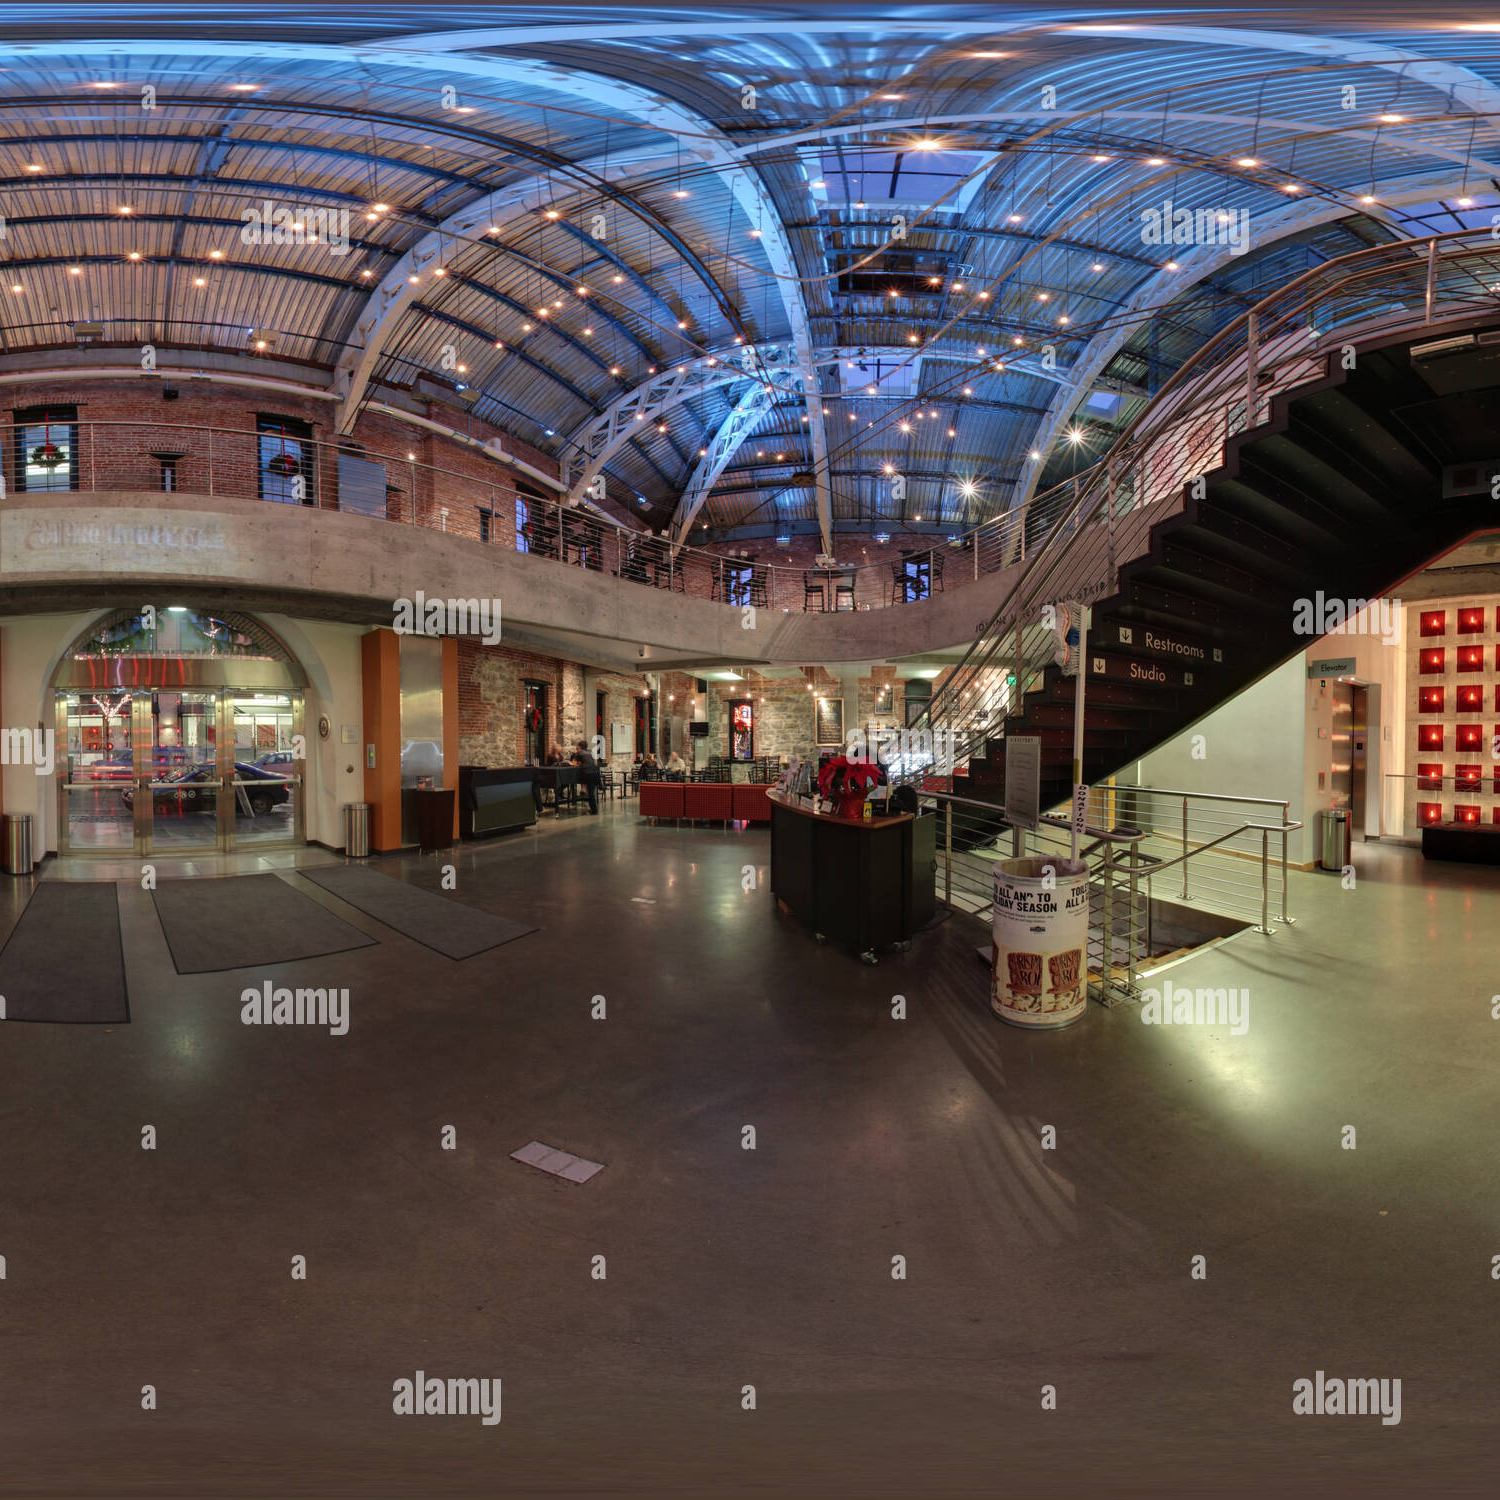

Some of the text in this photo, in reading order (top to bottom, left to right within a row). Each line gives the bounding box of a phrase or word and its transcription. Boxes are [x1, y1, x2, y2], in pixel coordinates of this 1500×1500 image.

[1145, 632, 1205, 659] Restrooms
[1130, 663, 1166, 682] Studio
[1321, 664, 1348, 672] Elevator
[1075, 785, 1088, 834] DONATIONS
[999, 887, 1011, 898] ALL
[1037, 893, 1051, 902] TO
[1017, 903, 1057, 912] SEASON
